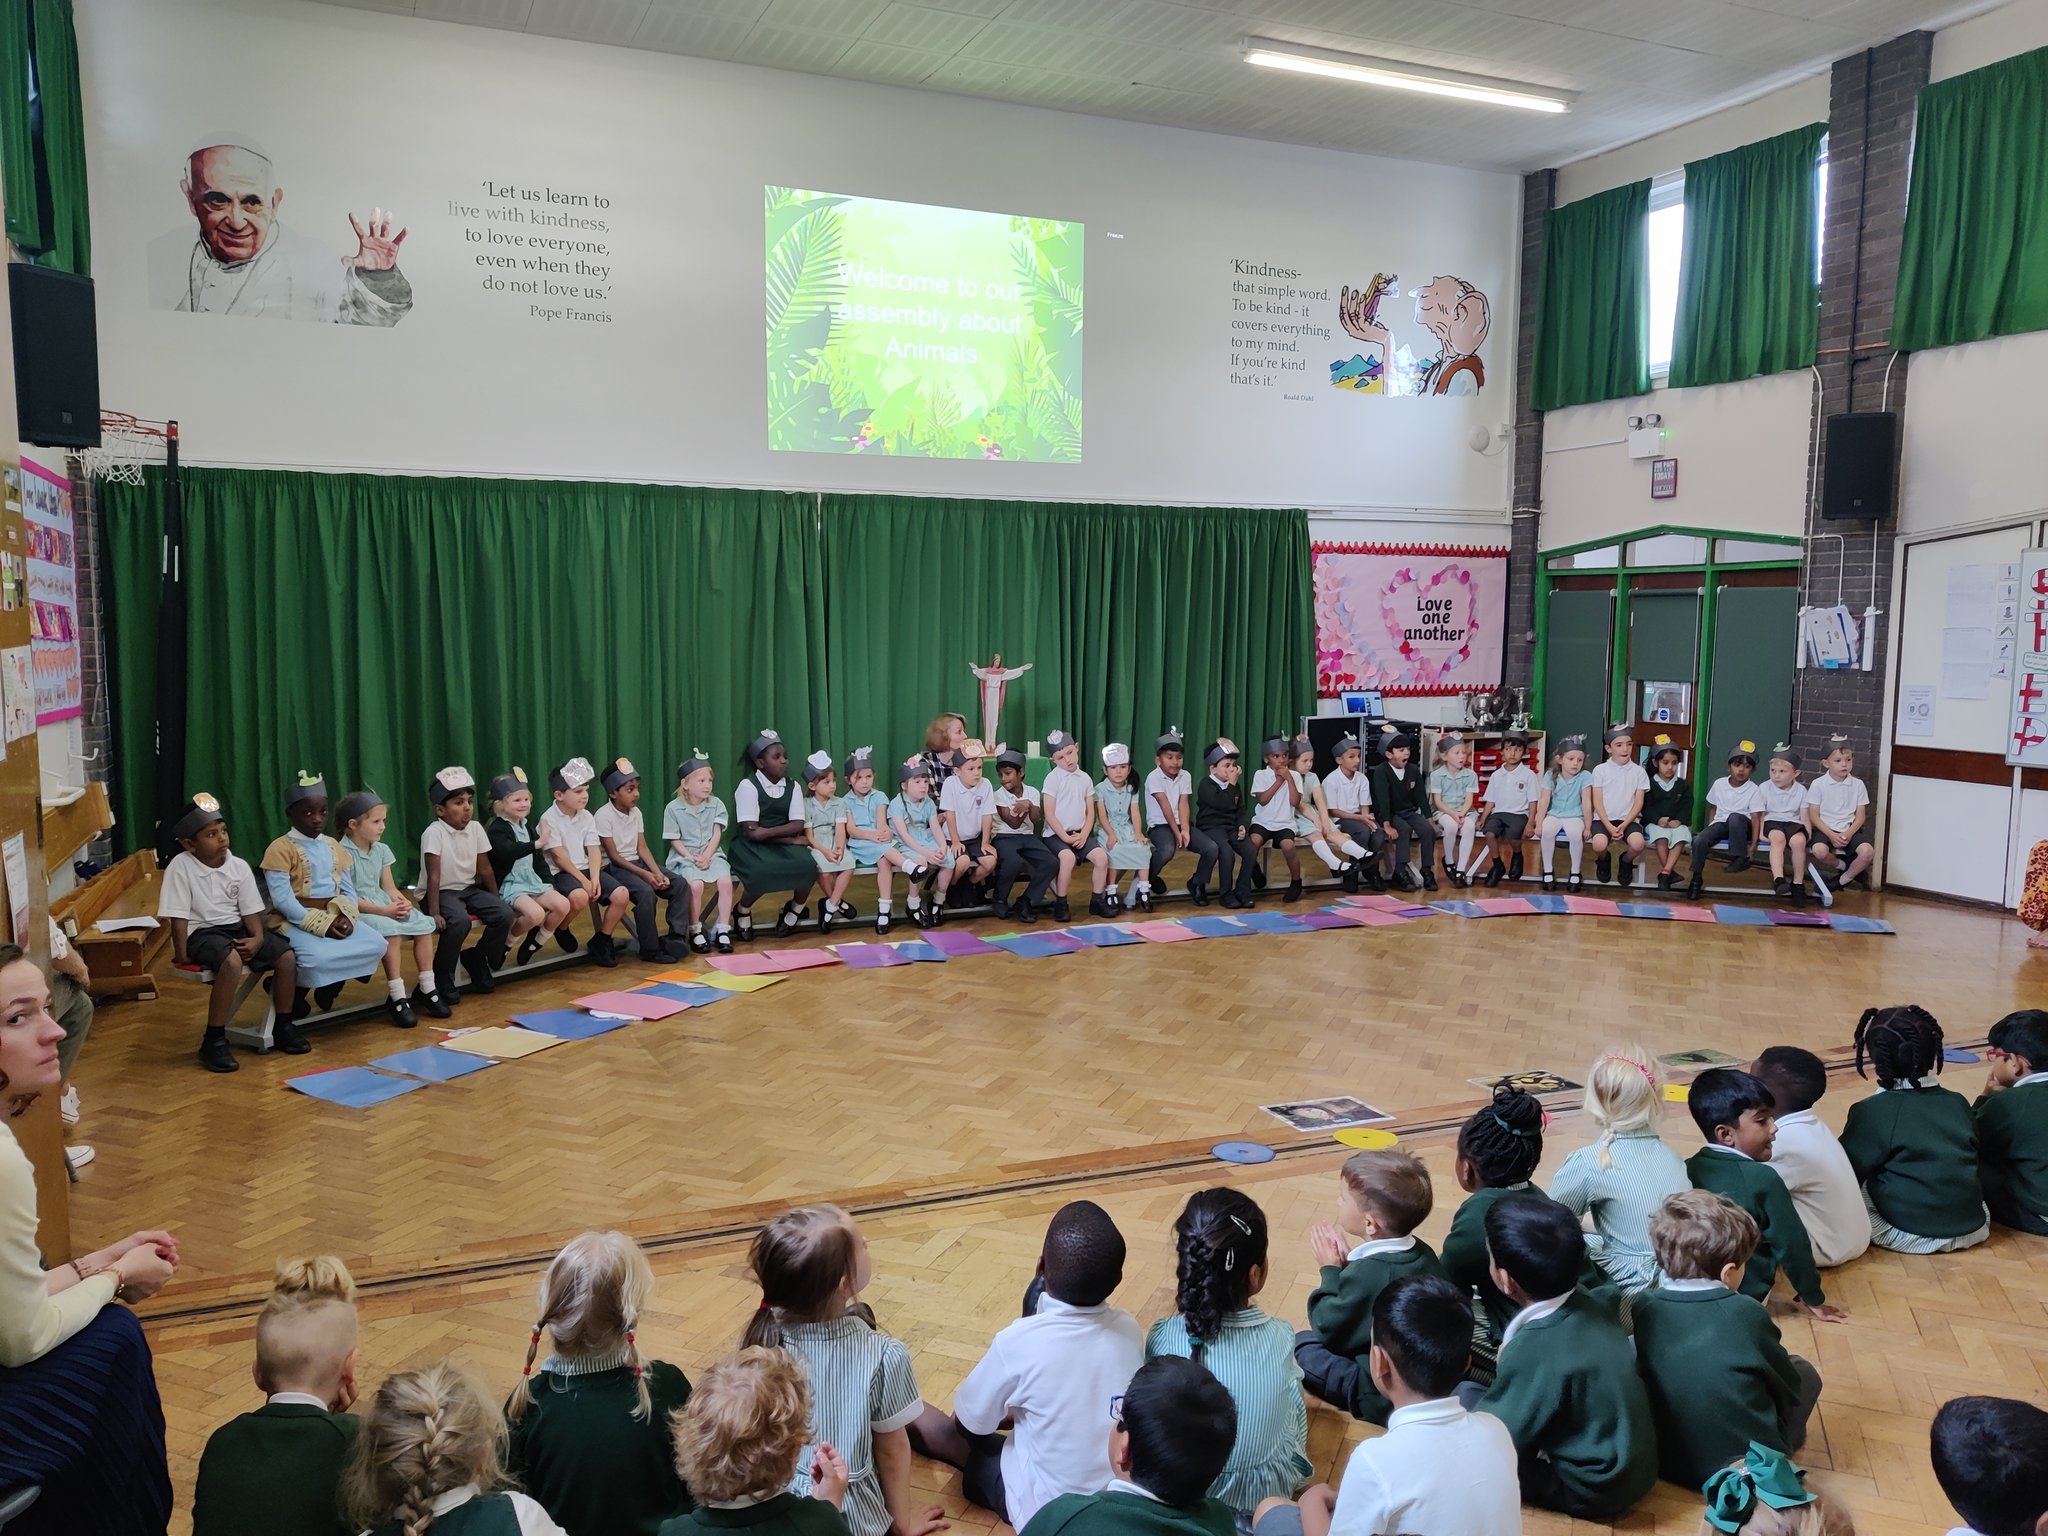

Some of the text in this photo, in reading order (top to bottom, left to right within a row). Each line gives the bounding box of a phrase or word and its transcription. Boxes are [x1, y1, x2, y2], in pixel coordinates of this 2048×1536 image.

[521, 189, 540, 201] us
[546, 188, 588, 207] learn
[594, 195, 610, 209] to
[448, 201, 610, 233] live with kindness,
[466, 228, 610, 256] to love everyone,
[476, 255, 610, 281] even when they
[482, 275, 505, 291] do
[510, 281, 538, 294] not
[544, 280, 578, 297] love
[837, 263, 1021, 301] Welcome to our
[1232, 280, 1330, 301] that simple word.
[530, 305, 612, 322] Pope Francis
[839, 301, 1022, 335] assembly about
[1232, 299, 1246, 312] To
[1249, 300, 1262, 312] be
[1266, 302, 1290, 315] kind
[1302, 306, 1309, 317] it
[1232, 320, 1330, 340] covers everything
[885, 337, 978, 364] Animals
[1232, 337, 1300, 352] to my mind.
[1231, 354, 1240, 366] If
[1281, 359, 1305, 371] kind
[1417, 596, 1452, 611] Love
[1422, 612, 1450, 624] one
[1404, 625, 1465, 641] another
